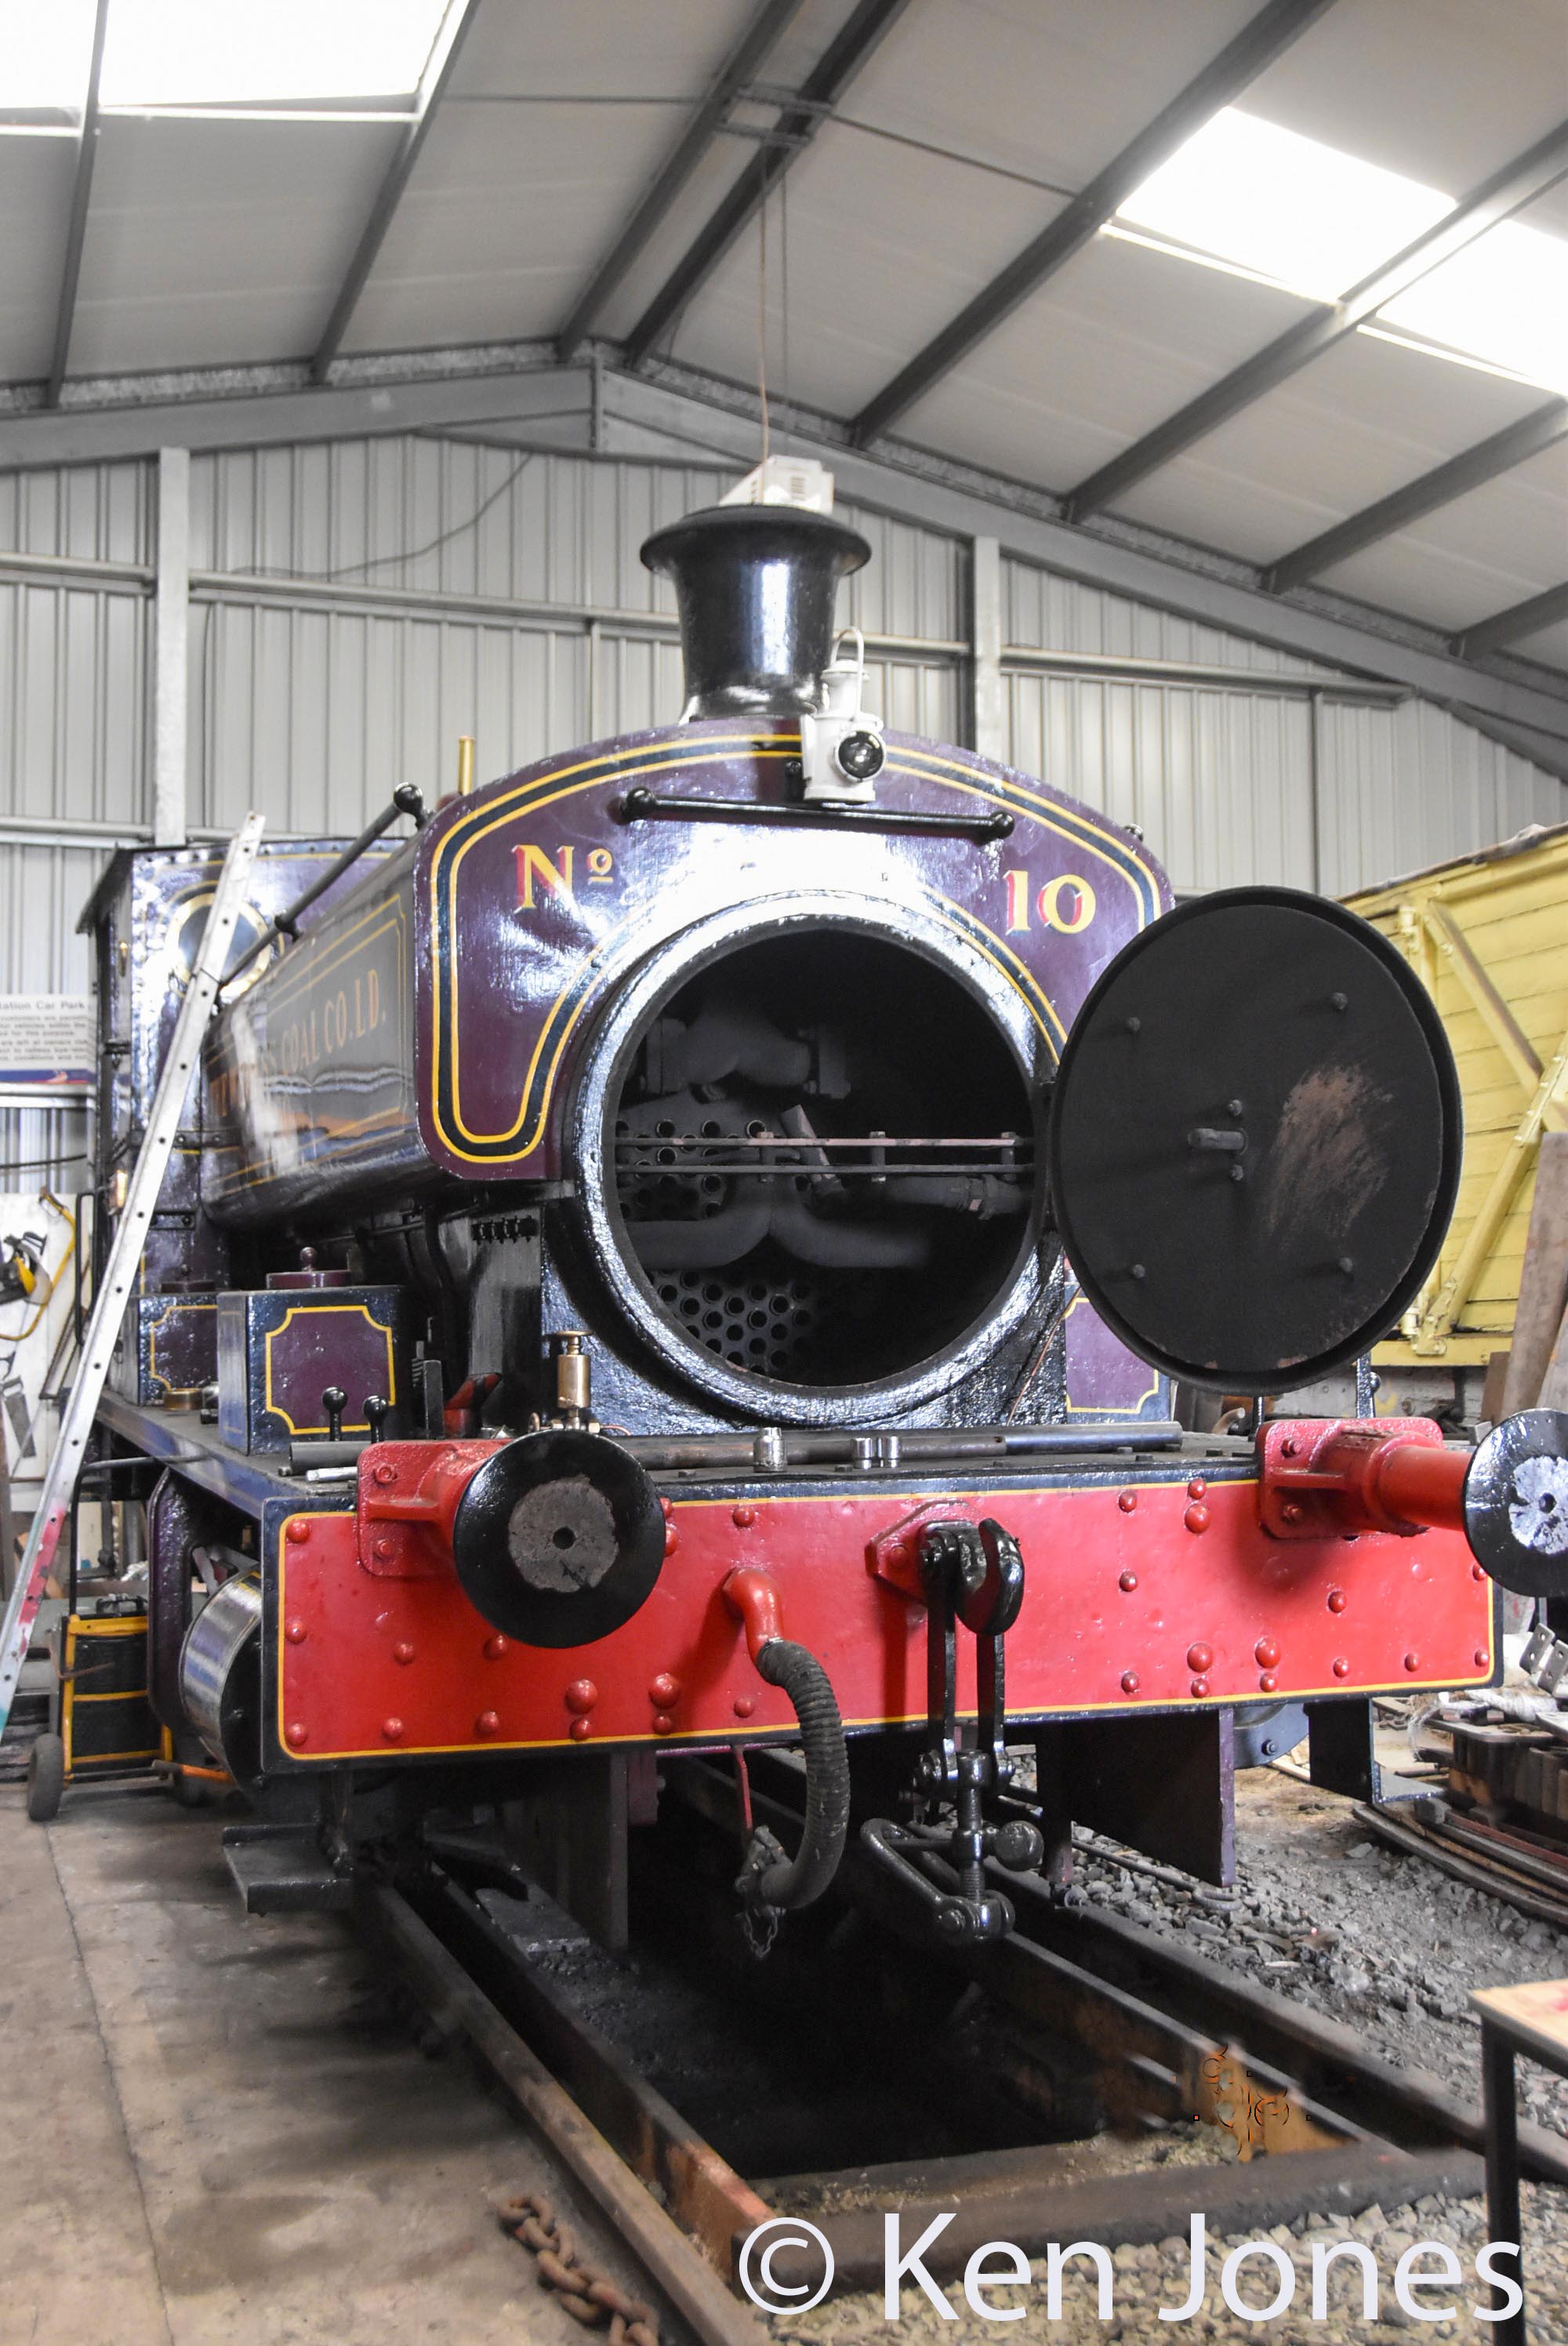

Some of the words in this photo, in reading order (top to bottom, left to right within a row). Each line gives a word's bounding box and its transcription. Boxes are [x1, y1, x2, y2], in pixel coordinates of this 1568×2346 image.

[1003, 870, 1096, 937] 10
[36, 1000, 55, 1010] Car
[60, 1000, 85, 1009] Park
[281, 1008, 321, 1076] COAL
